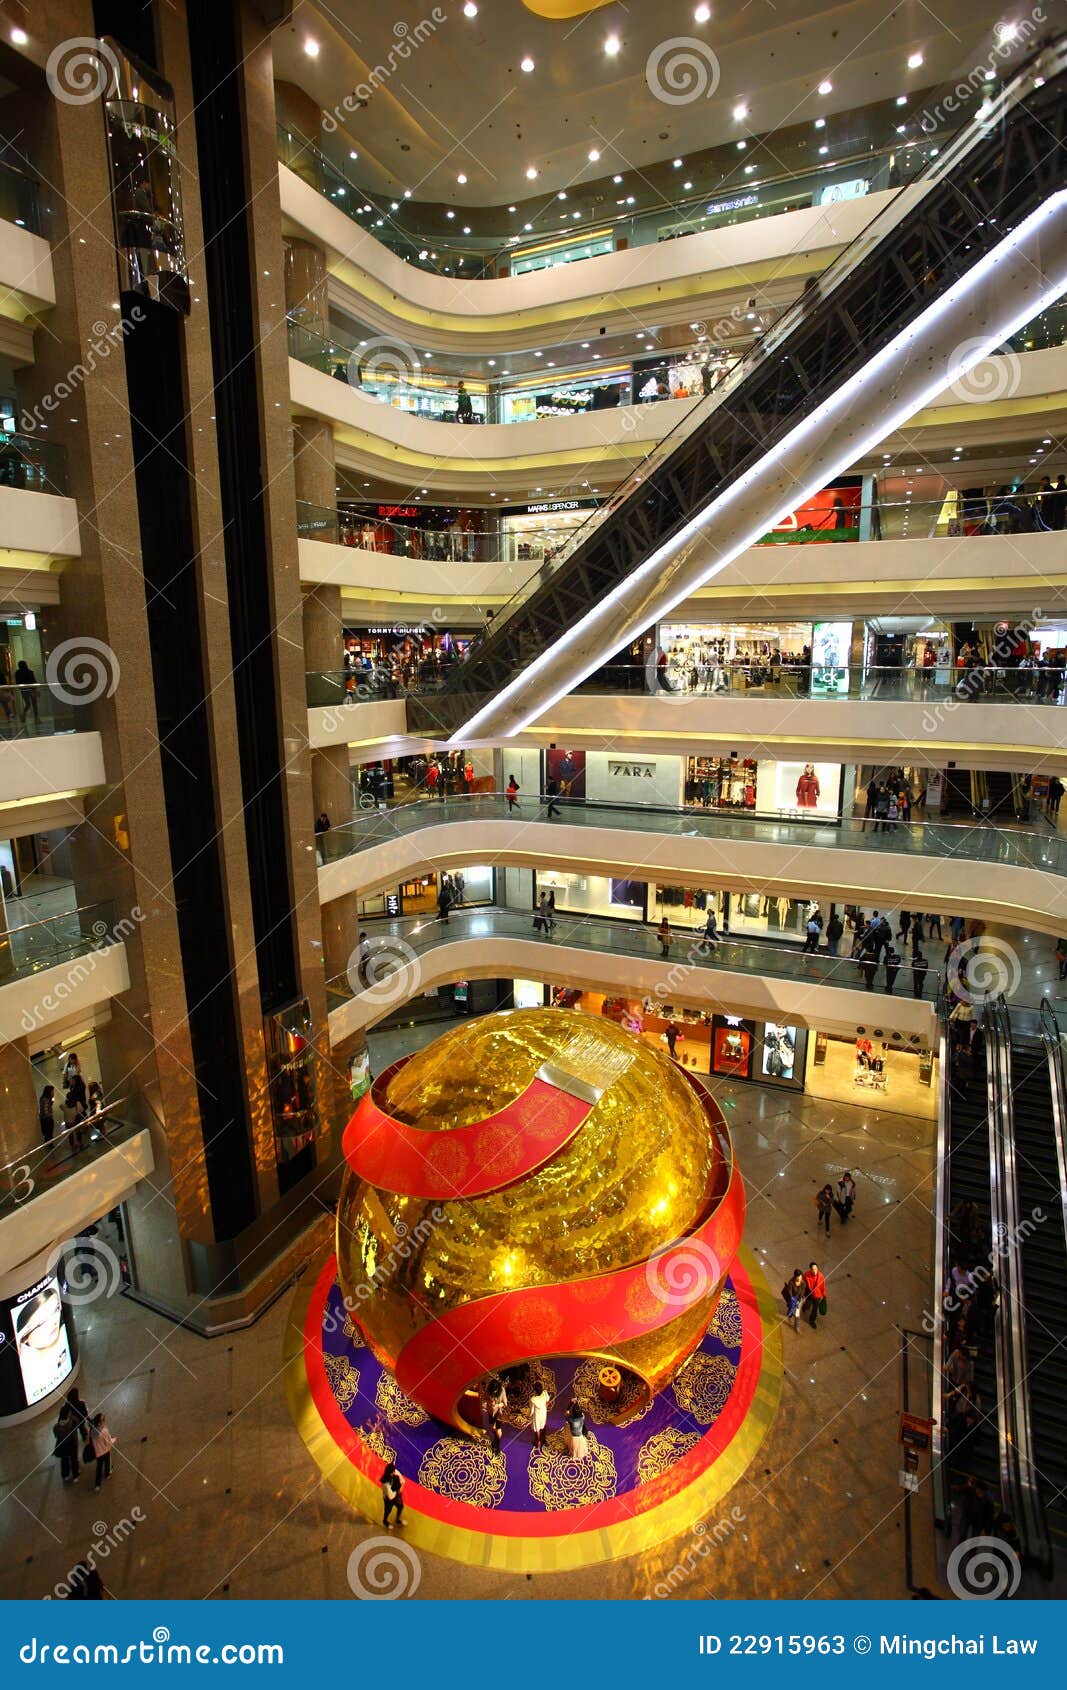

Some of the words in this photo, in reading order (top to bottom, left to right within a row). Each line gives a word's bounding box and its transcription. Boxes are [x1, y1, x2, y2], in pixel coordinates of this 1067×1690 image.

[613, 765, 653, 778] ZARA
[11, 1165, 35, 1204] 3
[17, 1275, 54, 1303] CHANEL
